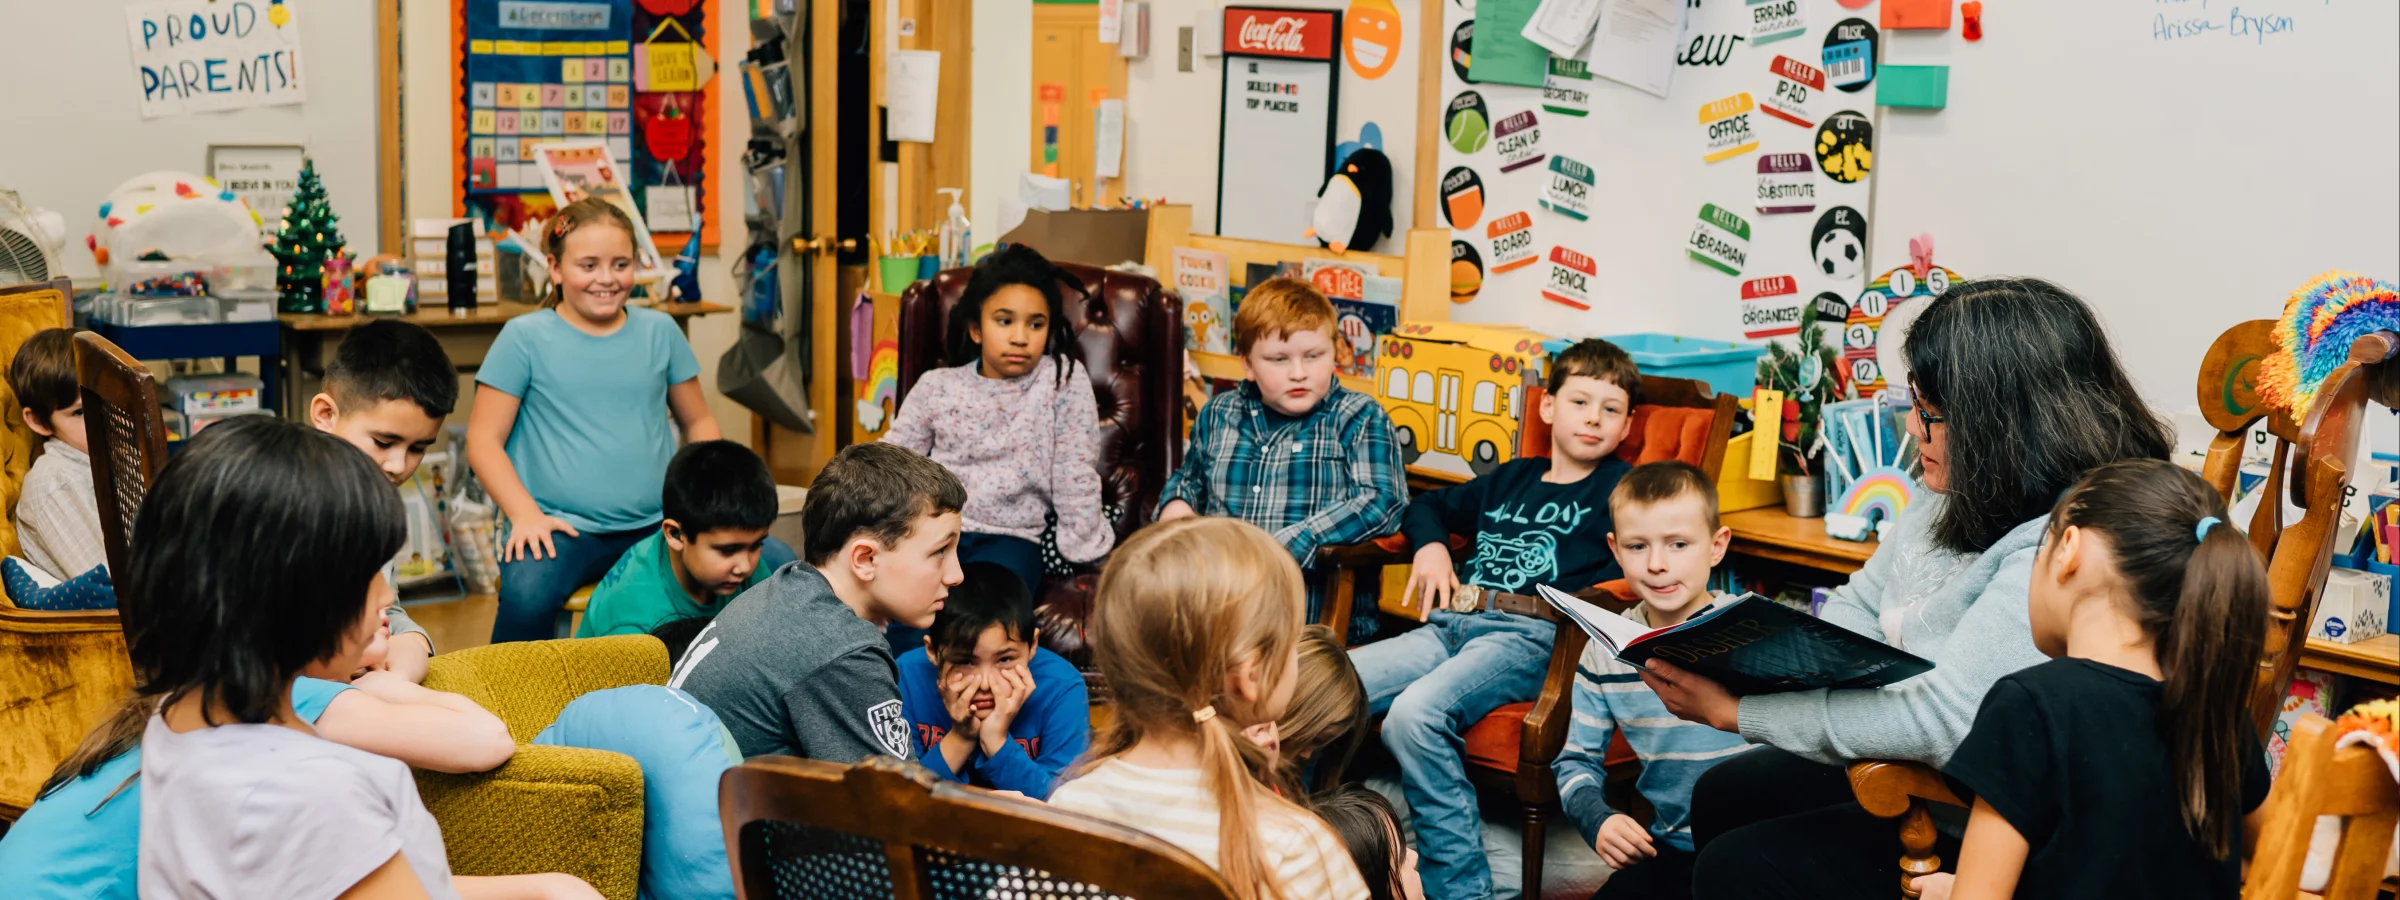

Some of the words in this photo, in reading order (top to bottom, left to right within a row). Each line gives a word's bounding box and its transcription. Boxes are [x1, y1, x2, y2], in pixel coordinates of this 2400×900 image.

[519, 7, 594, 26] December
[1754, 1, 1797, 24] ERRAND
[143, 2, 255, 50] PROUD
[2153, 13, 2224, 41] Arissa
[2230, 6, 2293, 45] Bryson
[1677, 34, 1745, 67] ew
[141, 51, 297, 101] PARENTS!
[592, 63, 599, 76] 2
[615, 64, 622, 76] 3
[1784, 58, 1816, 81] HELLO
[479, 89, 488, 100] 4
[505, 88, 512, 101] 5
[527, 89, 534, 101] 6
[550, 89, 558, 101] 7
[570, 89, 578, 101] 8
[612, 90, 625, 103] 10
[1543, 88, 1589, 105] SECRETARY
[1776, 79, 1807, 104] IPAD
[1247, 97, 1260, 109] TOP
[1264, 99, 1298, 113] PLACERS
[1710, 95, 1741, 114] HELLO
[479, 116, 488, 127] 11
[501, 117, 515, 129] 12
[524, 116, 537, 129] 13
[546, 117, 559, 128] 14
[568, 117, 582, 129] 15
[590, 117, 602, 129] 16
[613, 117, 625, 129] 17
[1503, 111, 1529, 128] HELLO
[1709, 114, 1750, 139] OFFICE
[1837, 115, 1855, 130] art
[1497, 135, 1528, 155] CLEAN
[1529, 130, 1541, 144] UP
[1560, 157, 1587, 177] HELLO
[1770, 153, 1801, 168] HELLO
[1552, 175, 1587, 200] LUNCH
[1757, 183, 1815, 200] SUBSTITUTE
[1496, 213, 1523, 231] HELLO
[1712, 208, 1742, 230] HELLO
[1493, 230, 1532, 257] BOARD
[1690, 231, 1746, 267] LIBRARIAN
[1561, 249, 1588, 268] HELLO
[1551, 265, 1588, 293] PENCIL
[1753, 277, 1785, 293] HELLO
[1900, 273, 1905, 292] 1
[1931, 272, 1944, 291] 5
[1868, 295, 1880, 314] 11
[1742, 307, 1800, 326] ORGANIZER
[1852, 328, 1866, 346] 9
[1856, 362, 1872, 381] 12
[1485, 502, 1529, 524] ALL
[1535, 502, 1592, 527] DAY
[1652, 619, 1781, 663] DASHER
